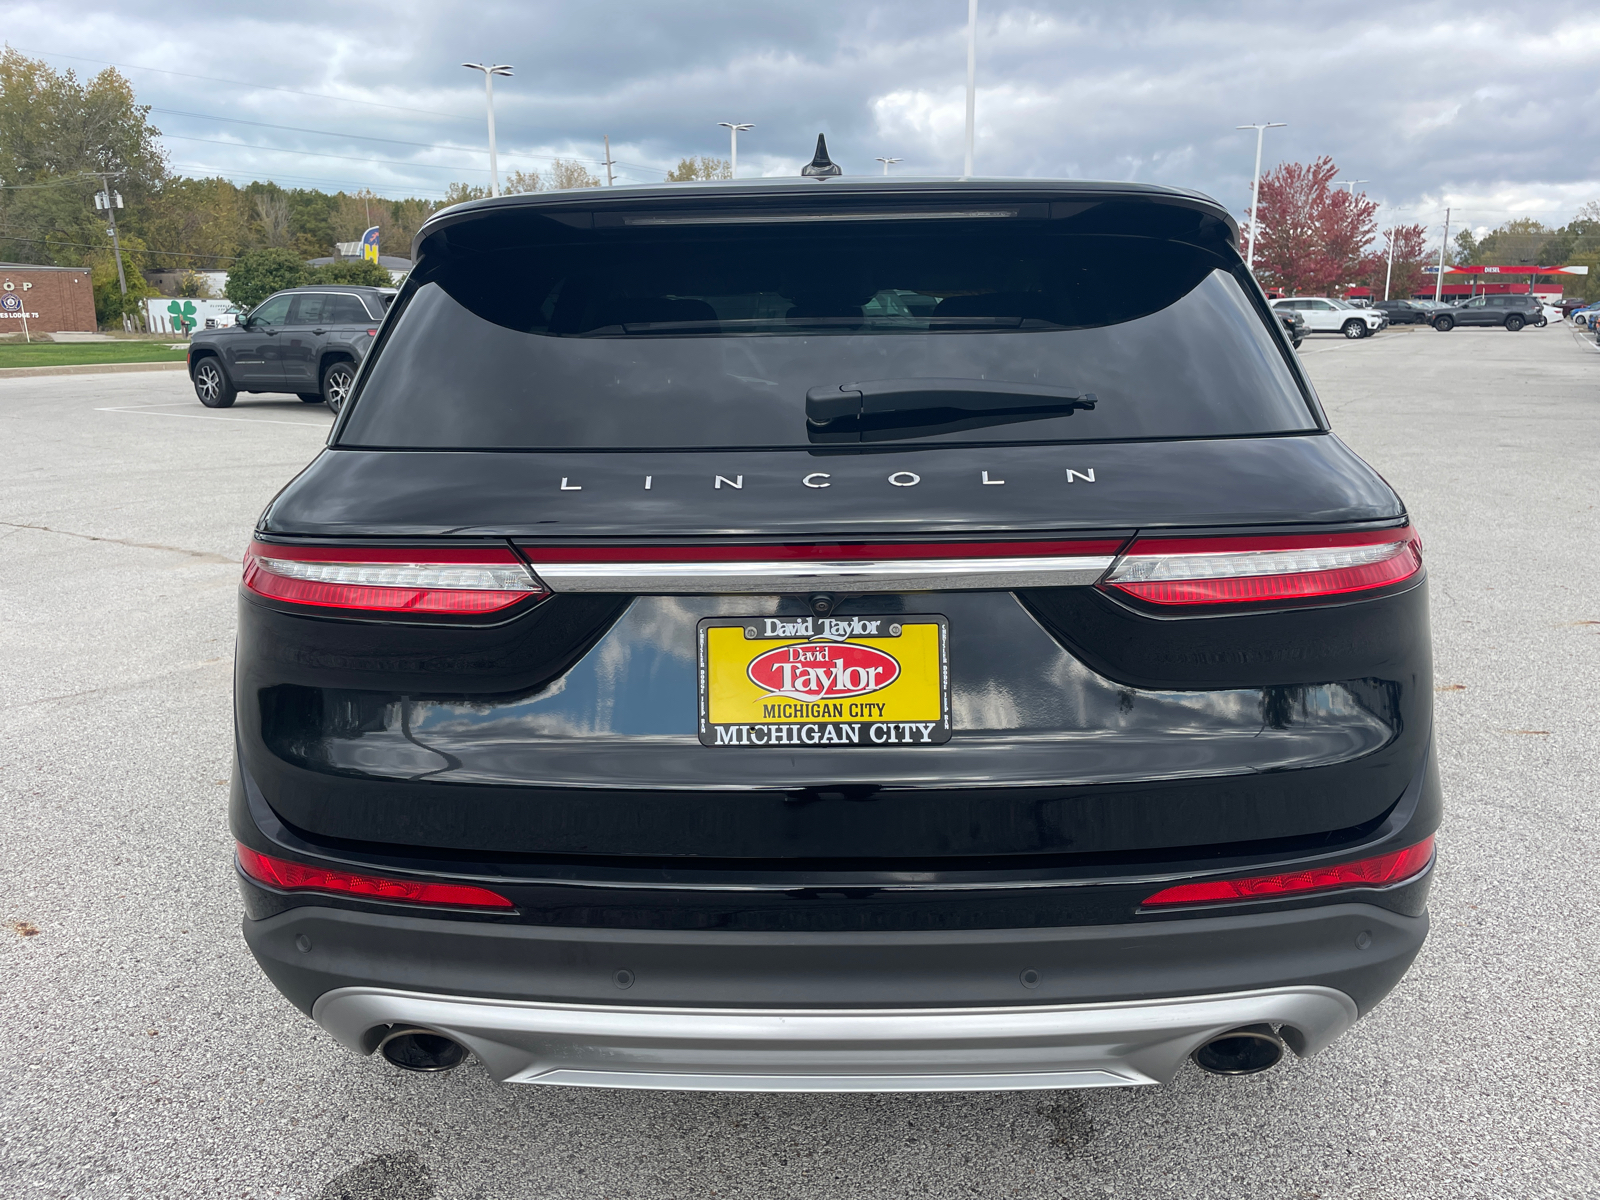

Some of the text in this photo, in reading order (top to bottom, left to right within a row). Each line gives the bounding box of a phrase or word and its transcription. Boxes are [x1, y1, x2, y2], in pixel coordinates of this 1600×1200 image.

[560, 466, 1096, 491] LINCOLN
[764, 616, 881, 641] David Taylor
[788, 647, 829, 662] David
[758, 658, 883, 702] Taylor
[762, 703, 886, 719] MICHIGAN CITY
[714, 722, 936, 745] MICHIGAN CITY
